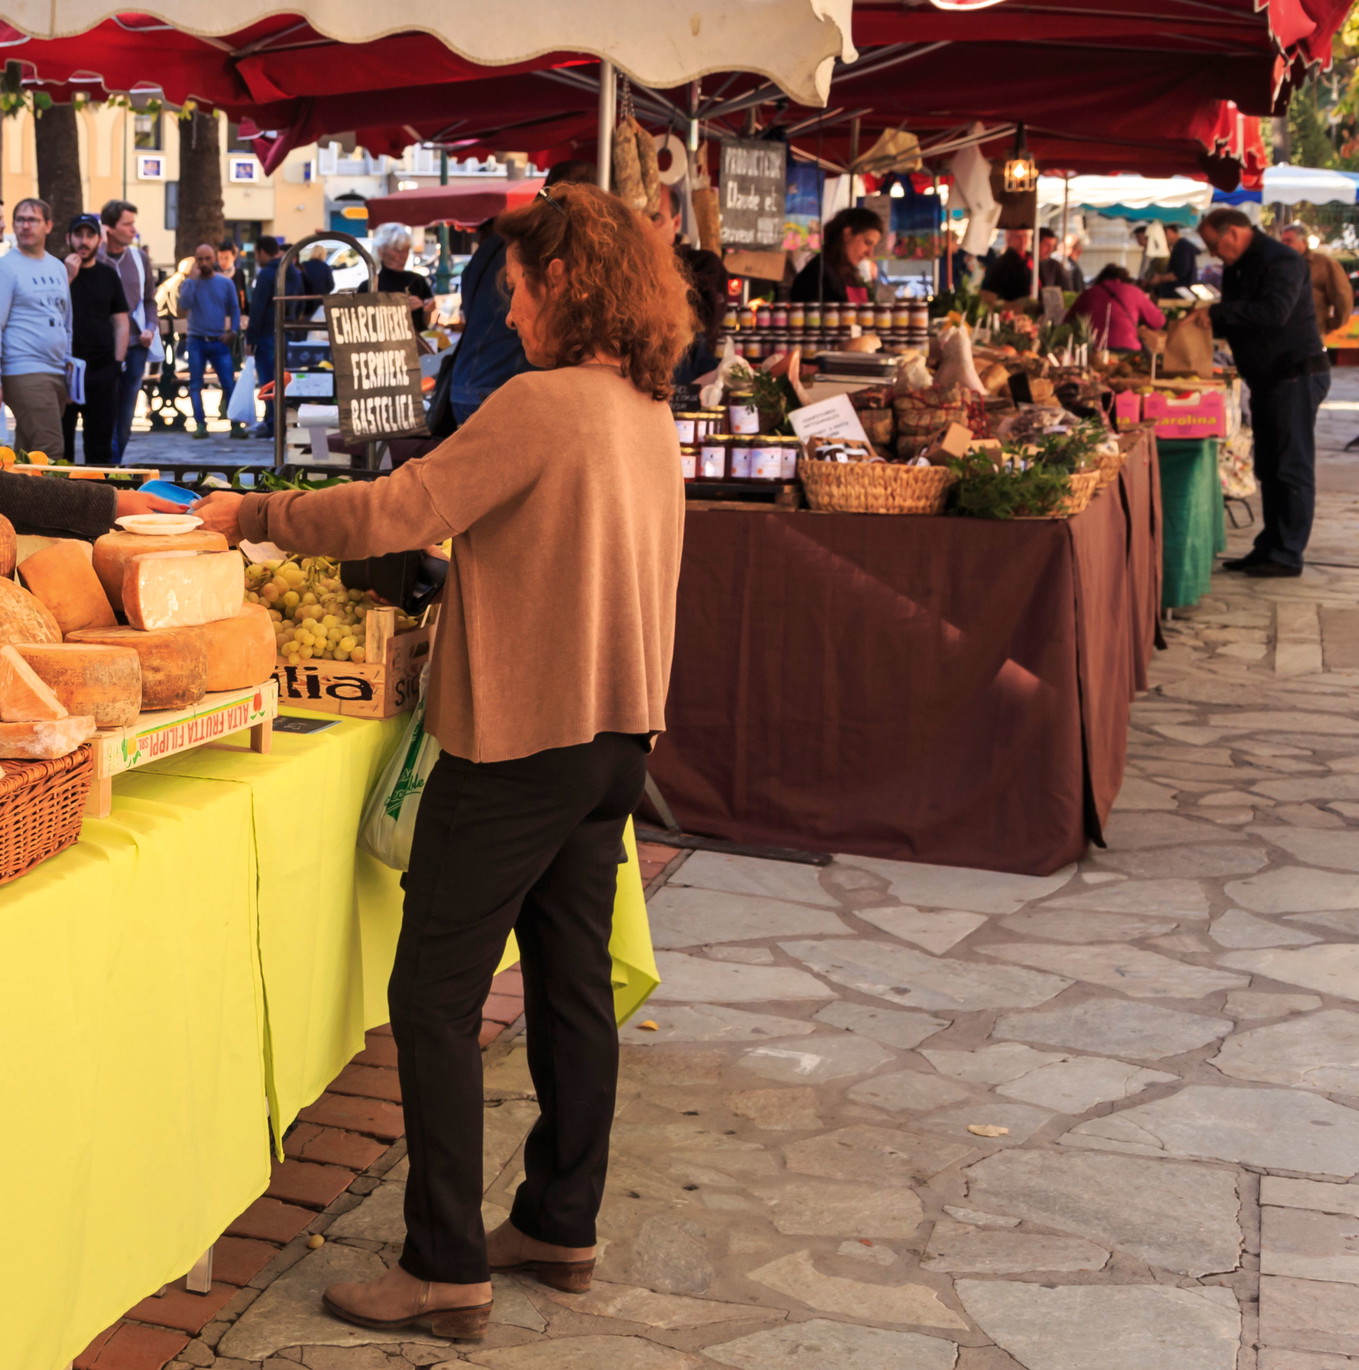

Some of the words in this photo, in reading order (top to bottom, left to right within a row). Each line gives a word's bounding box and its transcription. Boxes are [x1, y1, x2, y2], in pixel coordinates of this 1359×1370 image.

[331, 305, 412, 344] CHARCUTERIE
[351, 350, 409, 390] FERMIERE
[351, 395, 417, 435] BASTELICA
[187, 712, 224, 743] FRUTTA
[227, 703, 249, 731] ALTA
[149, 724, 185, 757] FILIPPI
